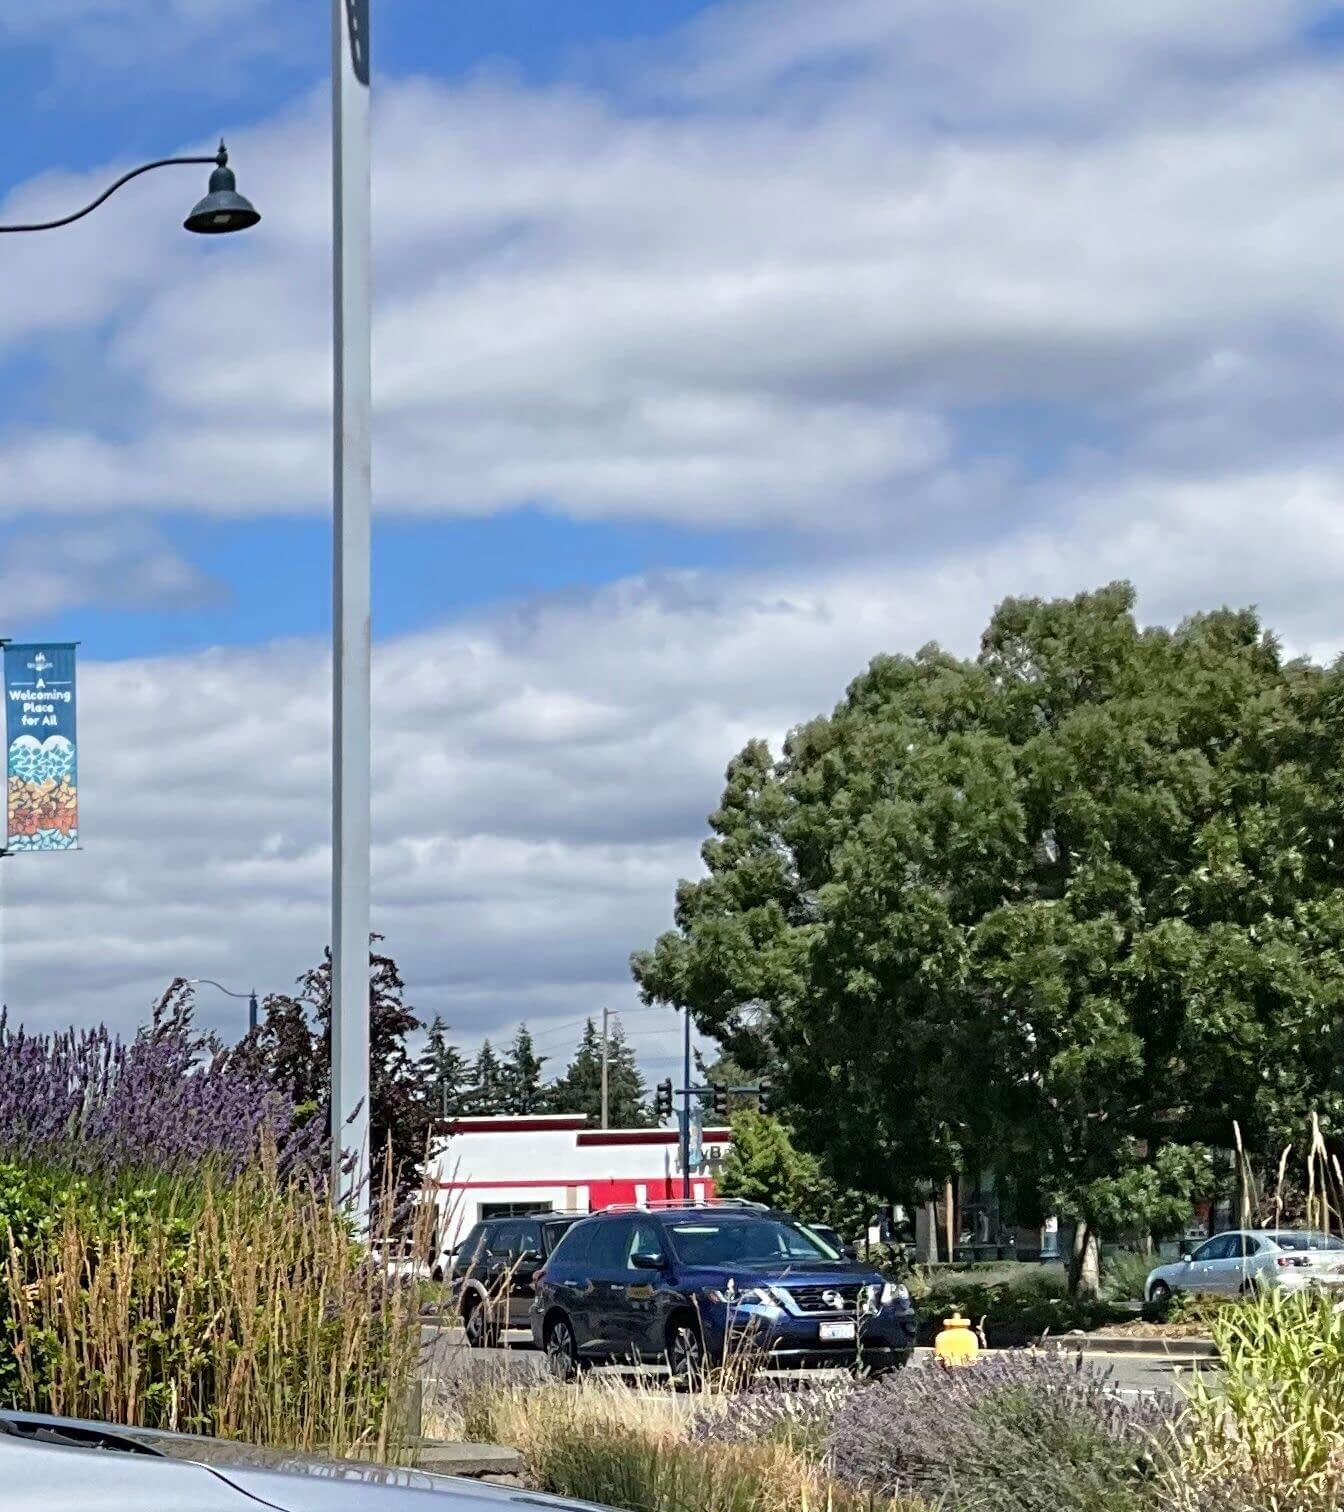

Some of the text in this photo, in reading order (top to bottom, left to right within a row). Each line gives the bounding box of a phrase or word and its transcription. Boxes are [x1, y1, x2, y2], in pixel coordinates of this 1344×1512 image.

[36, 678, 46, 688] A
[9, 689, 71, 703] Welcoming
[23, 702, 54, 712] Place
[22, 714, 57, 726] for All
